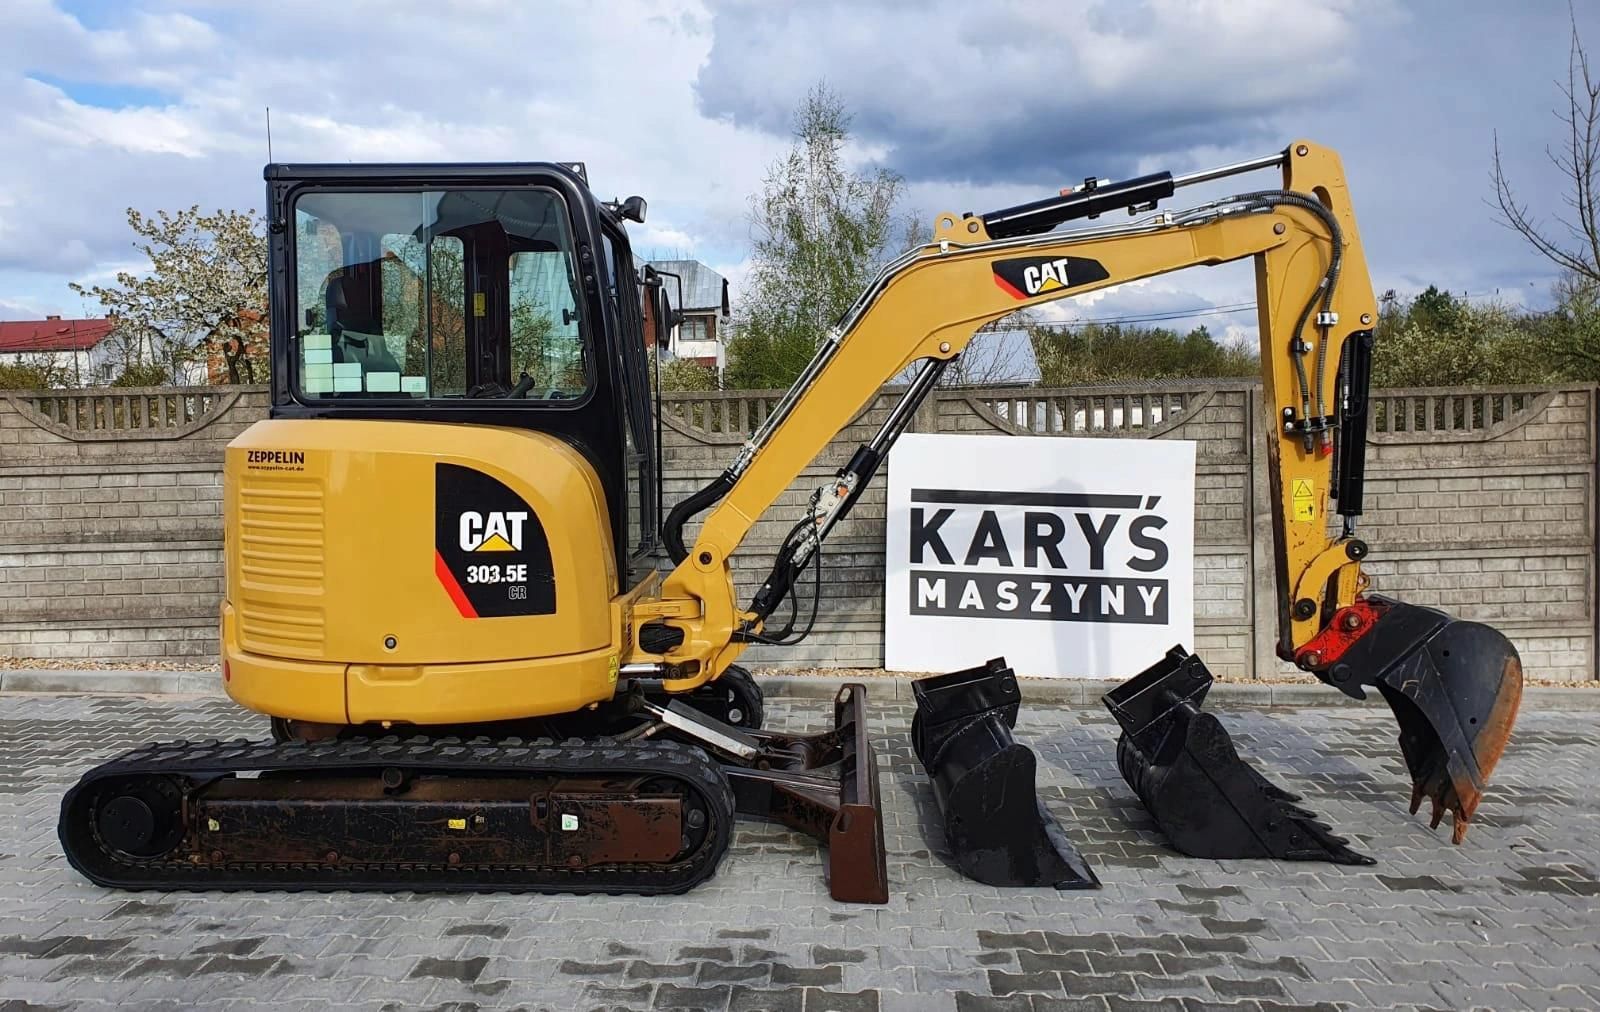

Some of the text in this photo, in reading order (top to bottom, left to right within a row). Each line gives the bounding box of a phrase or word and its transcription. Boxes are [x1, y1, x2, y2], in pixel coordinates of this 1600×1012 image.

[1023, 258, 1069, 294] CAT
[247, 450, 305, 464] ZEPPELIN
[459, 511, 528, 552] CAT
[909, 495, 1169, 573] KARYŚ
[466, 564, 527, 584] 303.5E
[508, 585, 527, 600] CR
[917, 577, 1162, 617] MASZYNY
